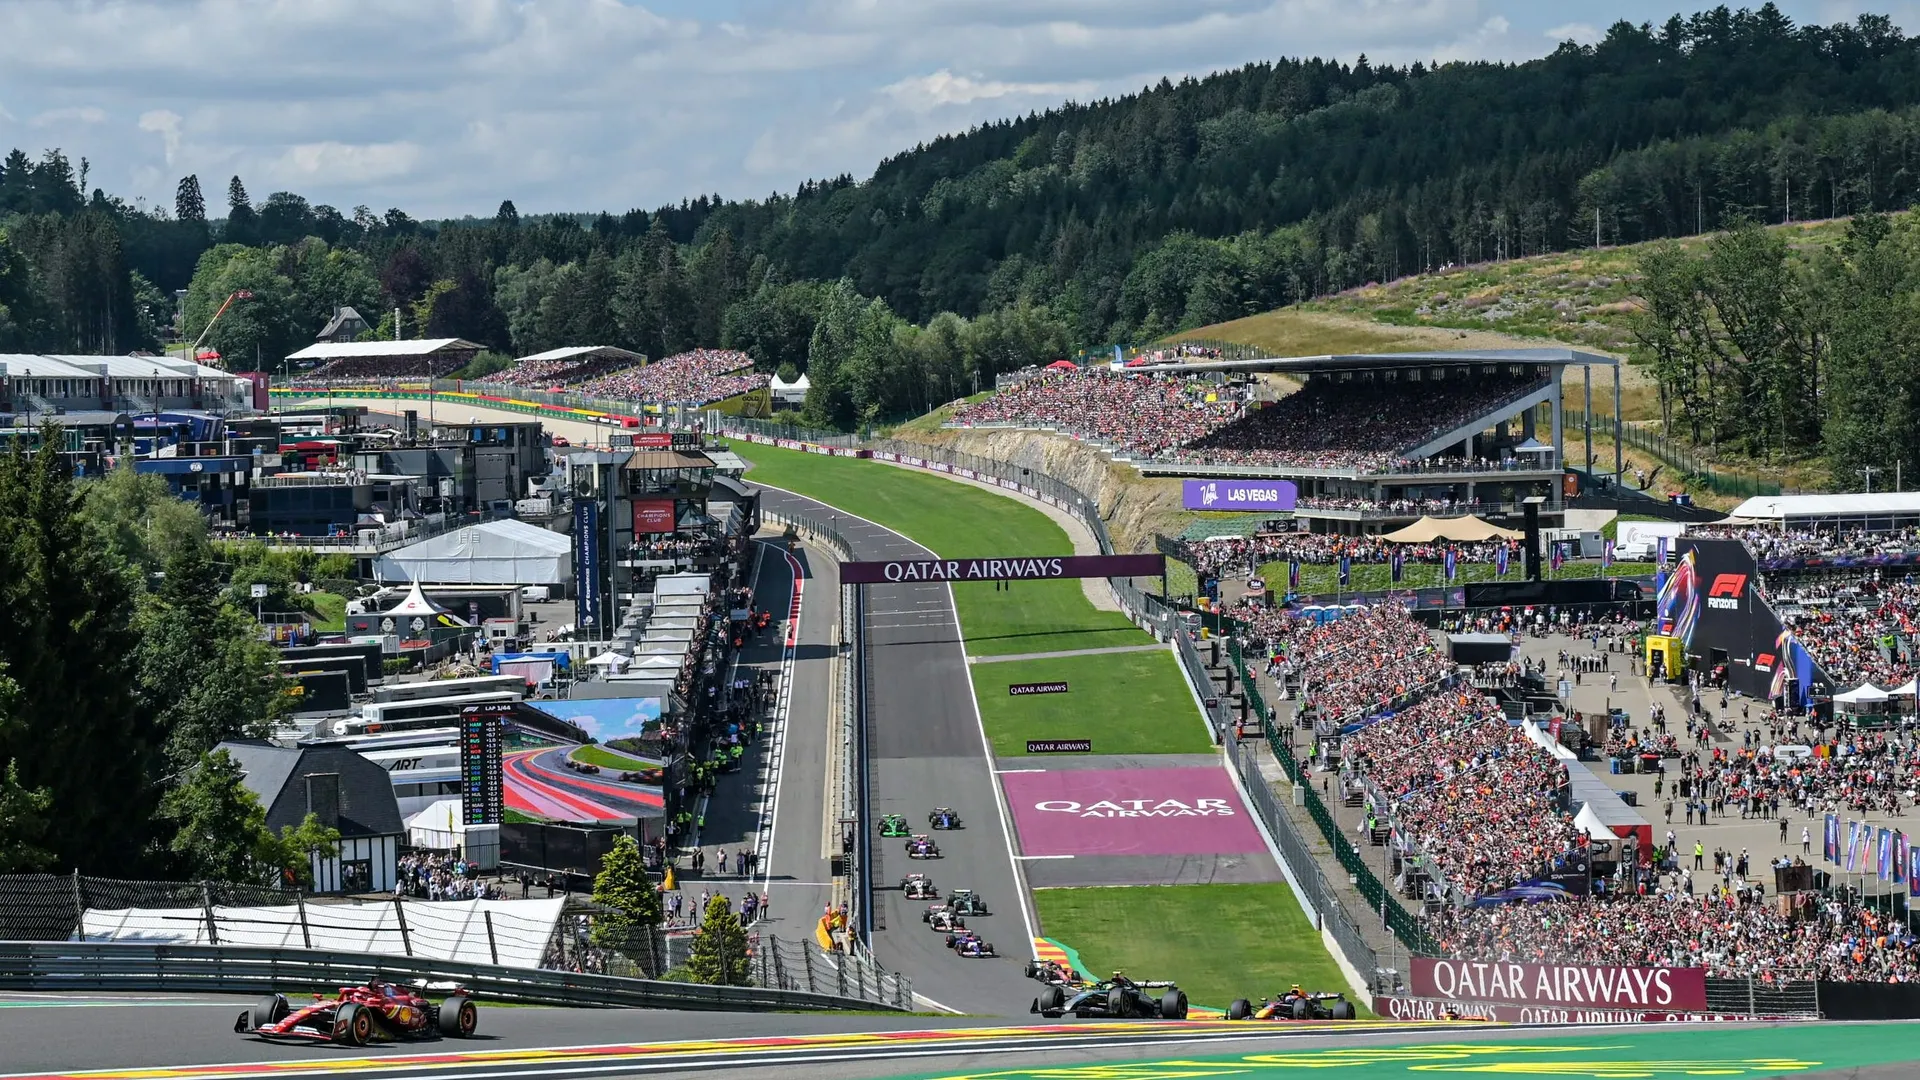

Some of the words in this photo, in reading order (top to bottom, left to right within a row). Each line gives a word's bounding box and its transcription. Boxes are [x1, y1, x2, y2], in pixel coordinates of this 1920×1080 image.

[1228, 488, 1247, 501] LAS
[1248, 488, 1278, 502] VEGAS
[884, 561, 960, 581] QATAR
[966, 558, 1062, 578] AIRWAYS
[1708, 574, 1746, 598] F1
[1708, 598, 1738, 610] Fanzone
[1010, 686, 1035, 694] QATAR
[1036, 684, 1066, 692] AIRWAYS
[1028, 743, 1054, 752] QATAR
[1056, 742, 1090, 750] AIRWAYS
[388, 758, 422, 771] ART
[1034, 799, 1232, 813] QATAR
[1080, 808, 1235, 818] AIRWAYS
[1434, 961, 1527, 998] QATAR
[1536, 966, 1672, 1004] AIRWAYS
[1390, 998, 1434, 1020] QATAR
[1438, 1002, 1496, 1022] AIRWAYS
